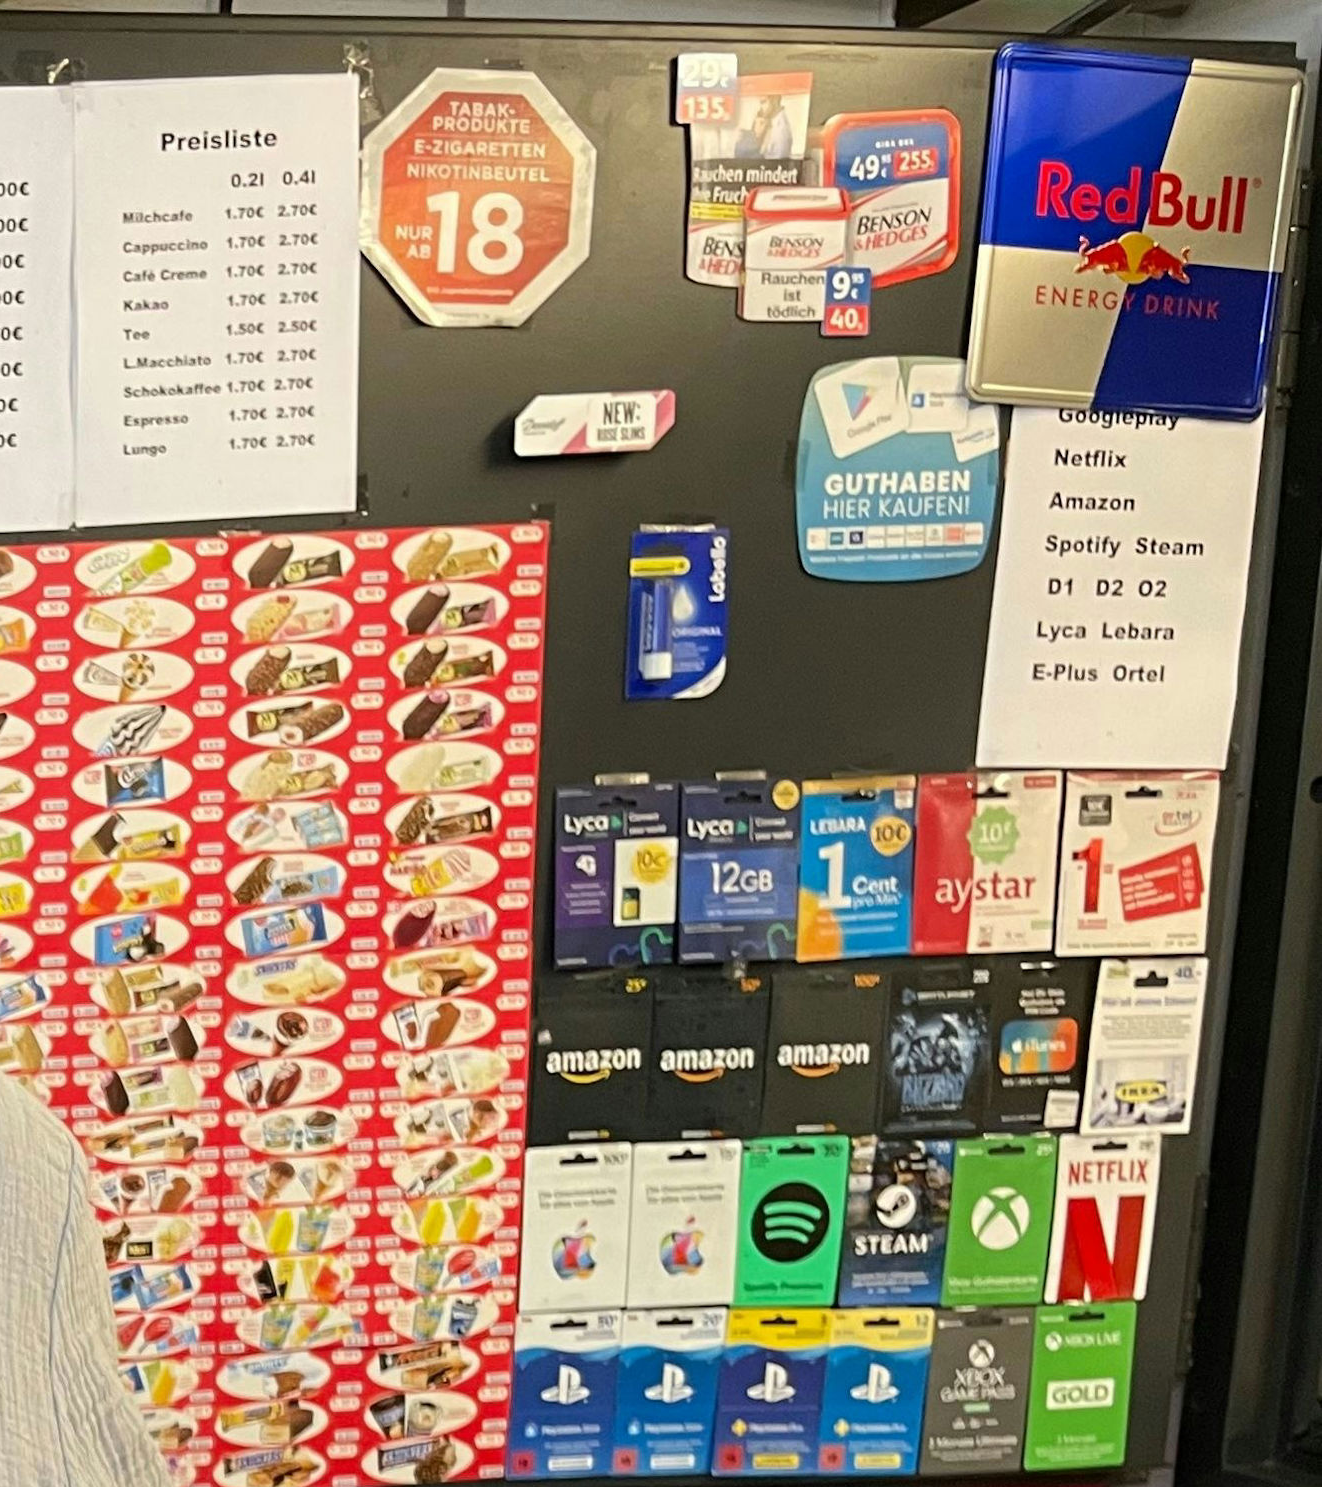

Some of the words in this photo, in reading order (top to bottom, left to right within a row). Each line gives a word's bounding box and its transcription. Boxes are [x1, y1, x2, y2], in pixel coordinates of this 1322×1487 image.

[450, 102, 516, 117] TABAK-
[433, 118, 530, 133] PRODUKTE
[161, 130, 277, 152] Preisliste
[415, 140, 545, 157] E-ZIGARETTEN
[407, 164, 549, 182] NIKOTINBEUTEL
[1036, 161, 1142, 224] Red
[1148, 172, 1248, 234] Bull
[857, 208, 932, 235] BENSON
[395, 225, 433, 240] NUR
[426, 190, 524, 275] 18
[123, 239, 208, 254] Cappuccino
[227, 236, 265, 249] 1.70€
[279, 234, 318, 247] 2.70€
[407, 245, 431, 259] AB
[761, 272, 824, 284] Rauchen
[784, 290, 801, 301] ist
[1036, 285, 1134, 311] ENERGY
[1145, 294, 1220, 320] DRINK
[767, 307, 815, 318] tödlich
[124, 414, 188, 428] Espresso
[230, 409, 267, 422] 1.70€
[276, 406, 315, 420] 2.70€
[604, 402, 641, 425] NEW:
[123, 444, 167, 457] Lungo
[230, 438, 267, 451] 1.70€
[276, 435, 315, 448] 2.70€
[1054, 449, 1127, 468] Netflix
[824, 470, 971, 495] GUTHABEN
[823, 499, 870, 519] HIER
[879, 497, 971, 518] KAUFEN!
[1049, 492, 1136, 511] Amazon
[1045, 535, 1121, 558] Spotify
[1136, 537, 1204, 556] Steam
[709, 536, 726, 602] Labello
[1048, 578, 1073, 595] D1
[1096, 579, 1123, 596] D2
[1036, 621, 1087, 642] Lyca
[1102, 623, 1175, 640] Lebara
[1033, 663, 1098, 682] E-Plus
[1113, 666, 1165, 682] Ortel
[688, 818, 734, 840] Lyca
[810, 819, 866, 834] LEBARA
[712, 862, 773, 893] 12GB
[547, 1048, 641, 1073] amazon
[1069, 1160, 1148, 1184] NETFLIX
[855, 1234, 928, 1255] STEAM
[1052, 1383, 1109, 1404] GOLD
